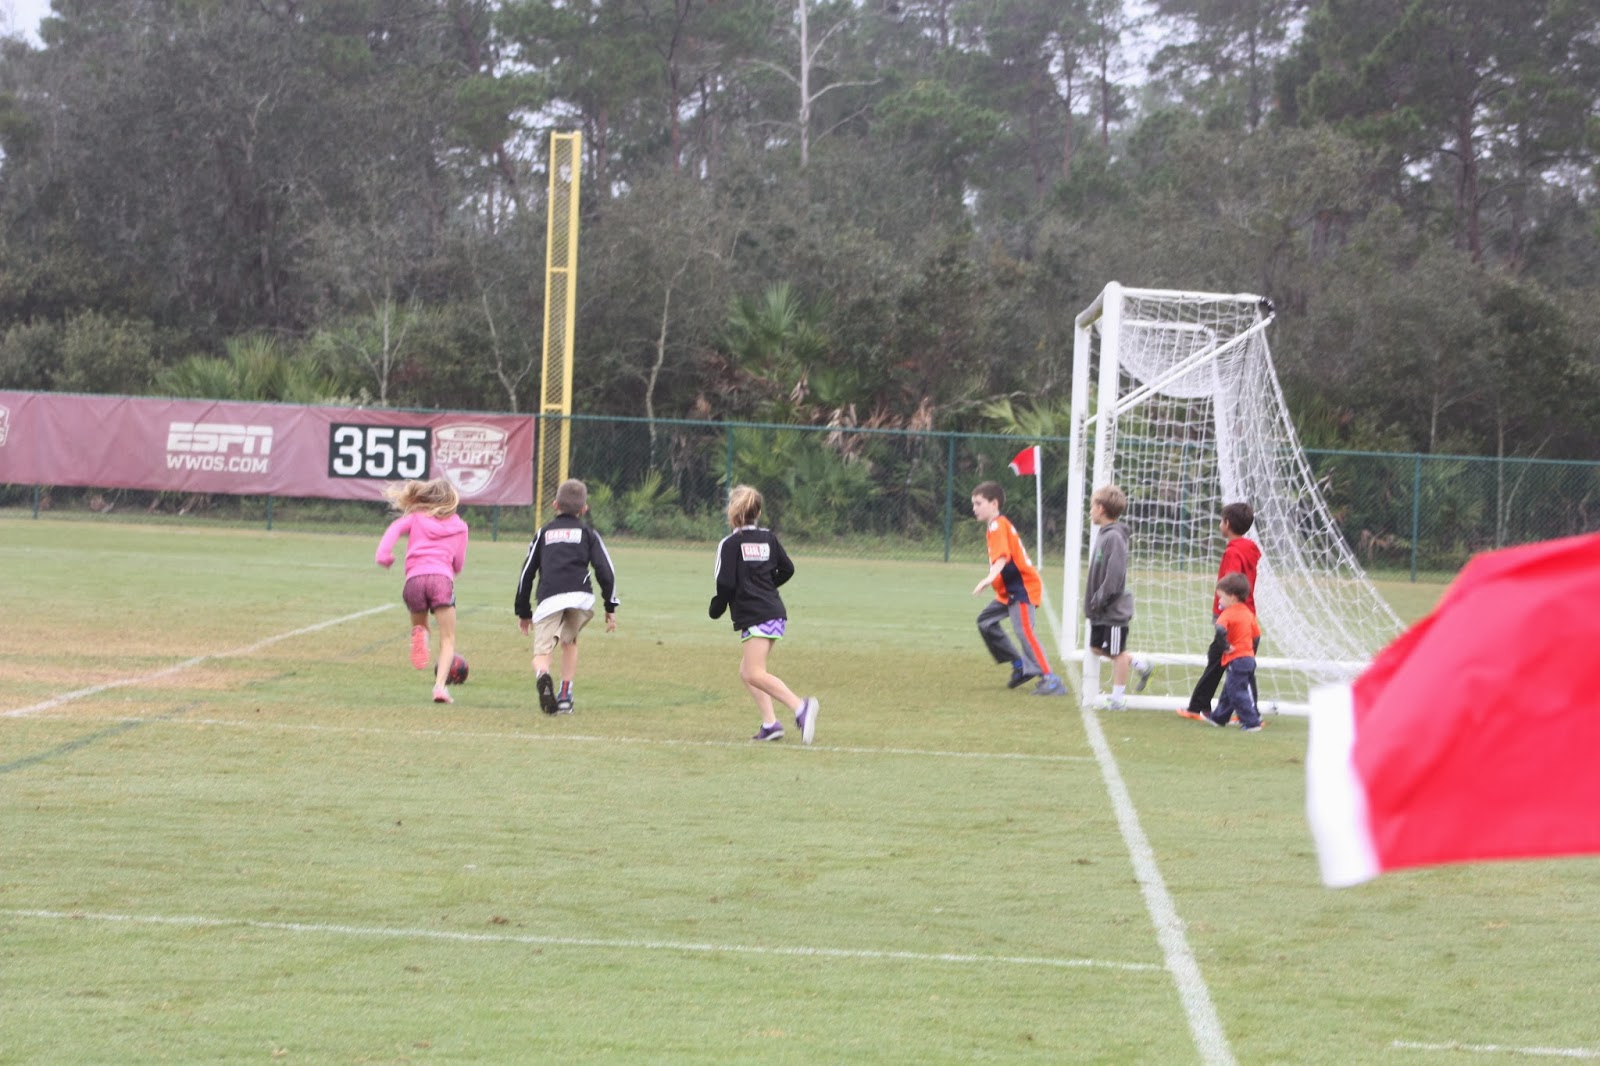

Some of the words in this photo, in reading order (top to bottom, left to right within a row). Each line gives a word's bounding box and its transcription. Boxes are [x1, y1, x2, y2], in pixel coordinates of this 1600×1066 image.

[166, 421, 274, 455] ESPN
[166, 454, 268, 474] WWOS.COM
[333, 426, 427, 479] 355
[436, 449, 504, 465] SPORTS
